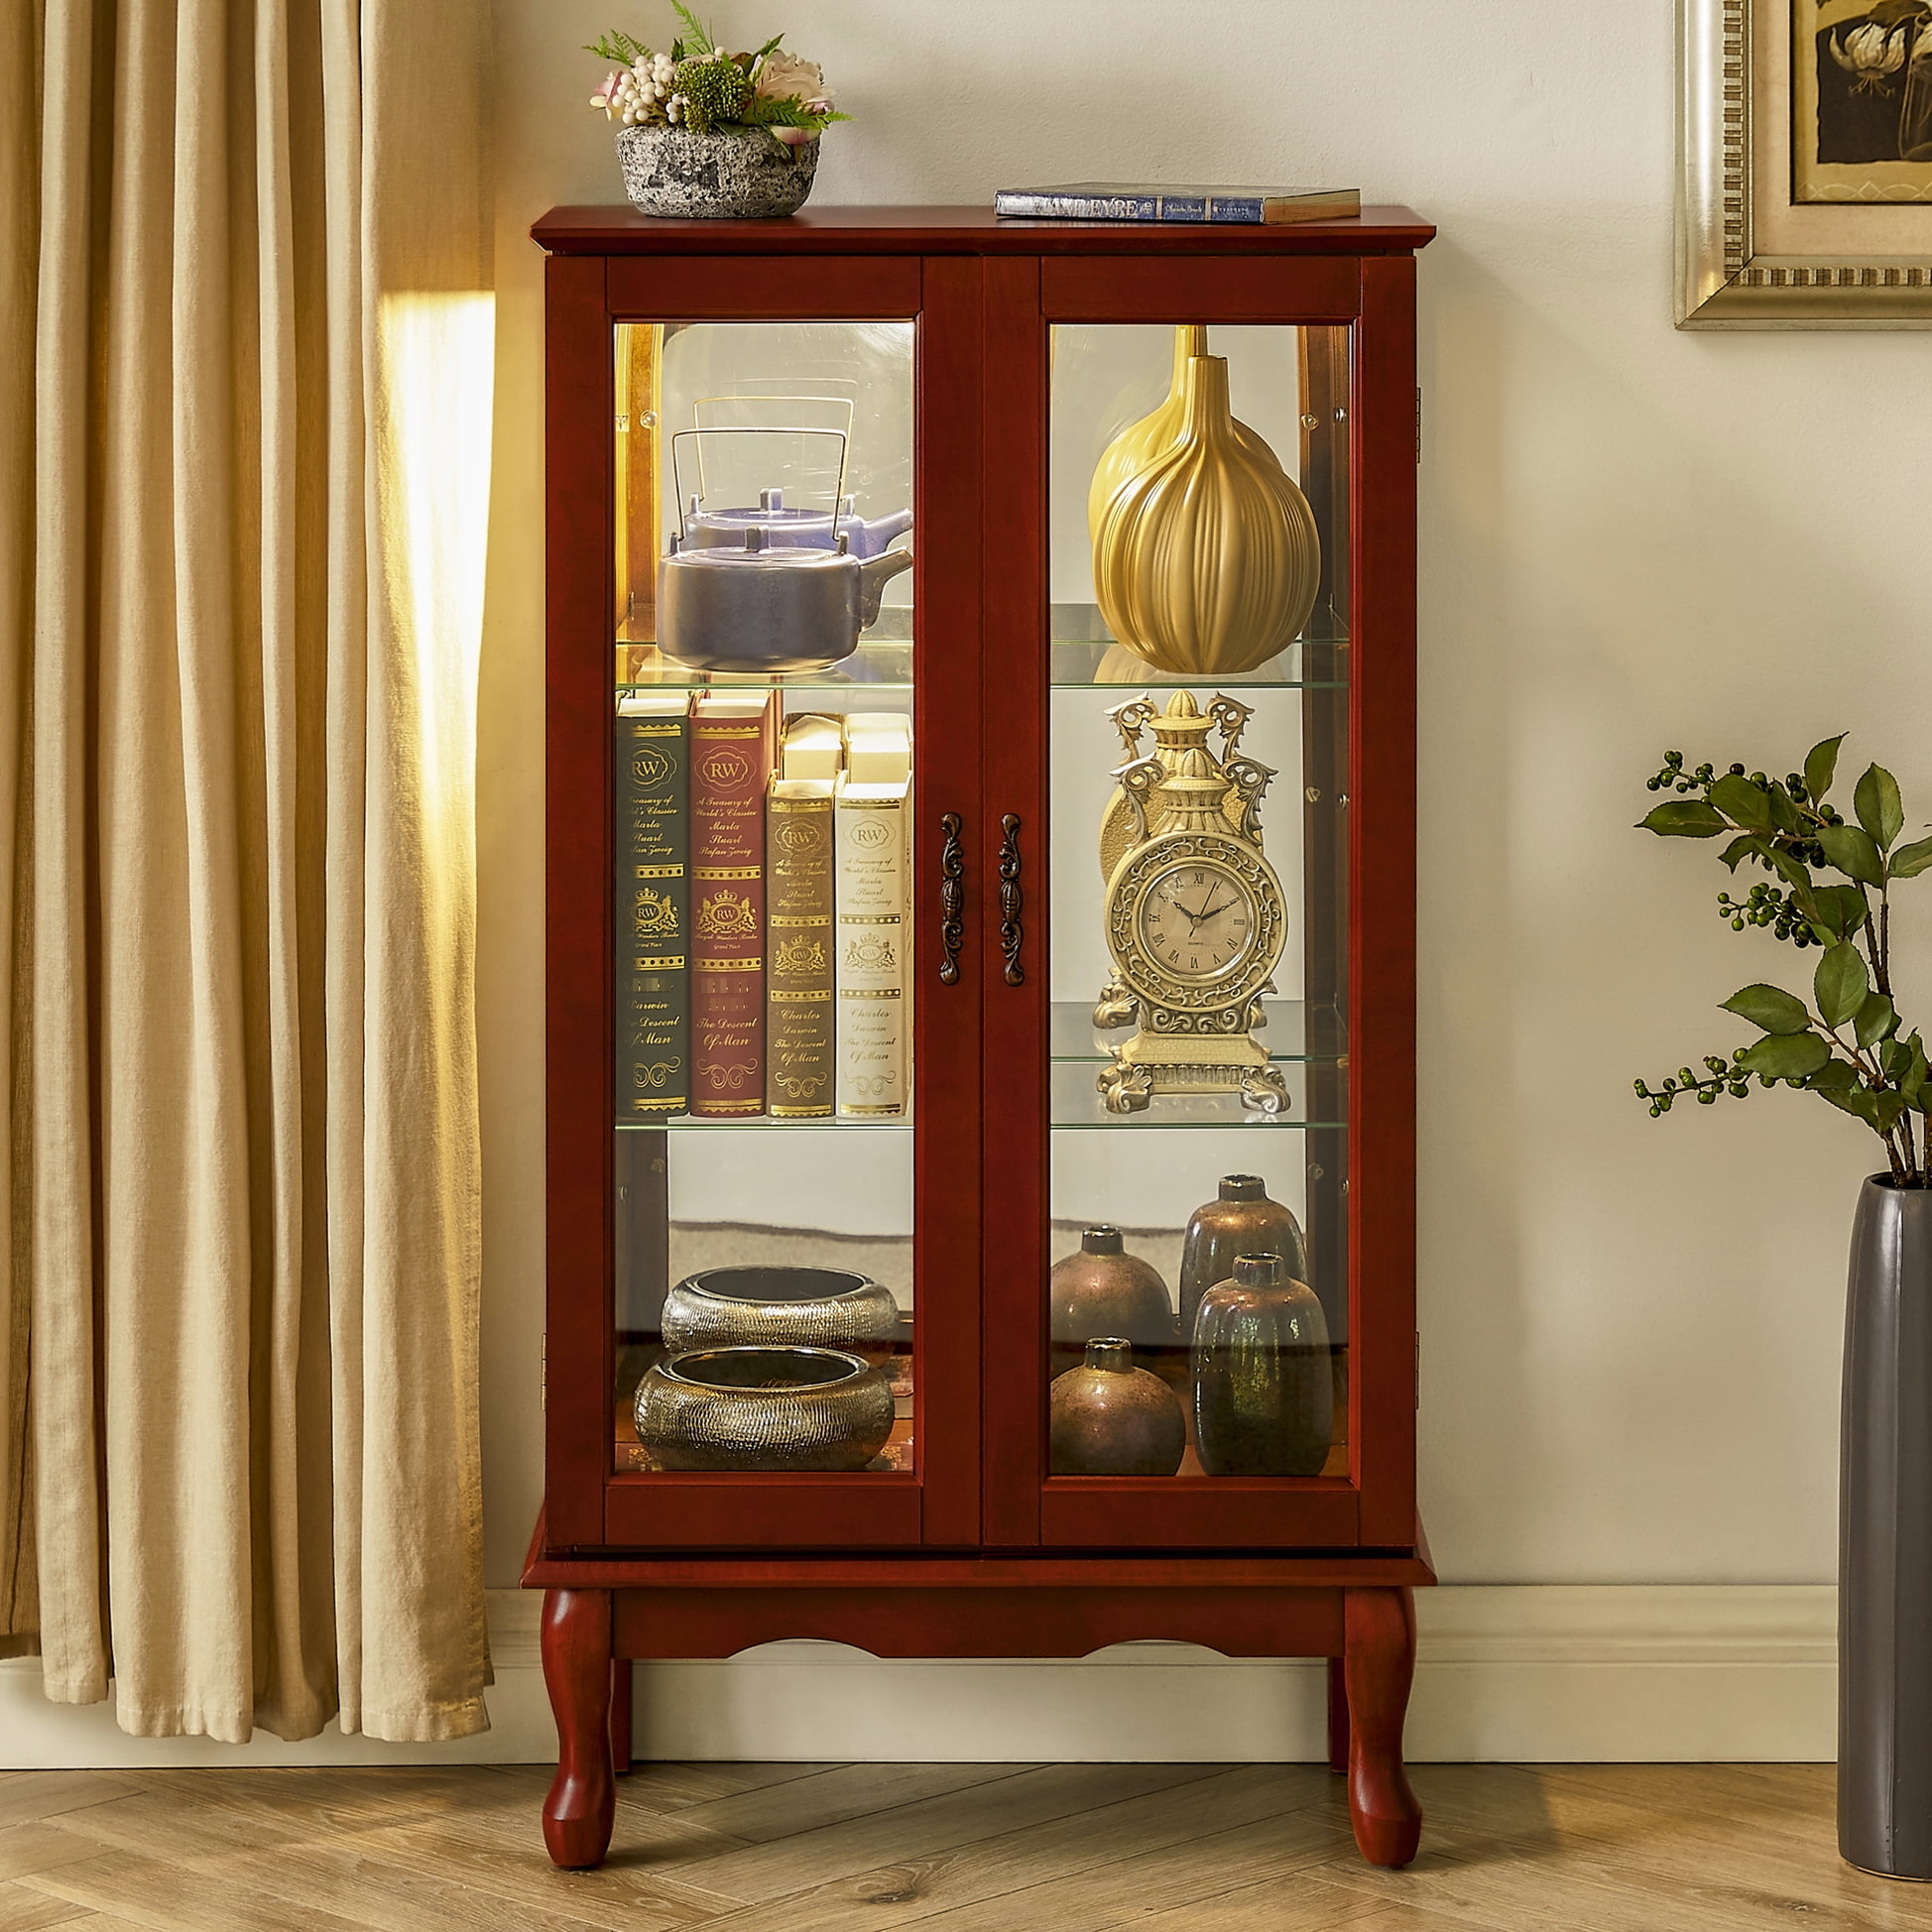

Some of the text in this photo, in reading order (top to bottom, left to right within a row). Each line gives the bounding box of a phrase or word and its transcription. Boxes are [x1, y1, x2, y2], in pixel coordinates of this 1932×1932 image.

[1090, 198, 1139, 217] EYRE
[631, 760, 661, 777] RW
[710, 762, 741, 779] RW
[706, 796, 742, 808] Treasury
[787, 831, 813, 844] RW
[857, 829, 883, 842] RW
[1193, 872, 1205, 884] XII
[637, 907, 658, 918] RW
[716, 909, 736, 920] RW
[781, 1008, 822, 1021] Charles
[849, 1008, 890, 1019] Charles
[639, 1015, 681, 1028] Descent
[695, 1018, 759, 1029] The Descent
[783, 1026, 818, 1034] Darwin
[640, 1031, 673, 1045] Man
[703, 1032, 752, 1051] Of Man
[775, 1038, 827, 1048] The Descent
[781, 1052, 820, 1066] Of Man
[863, 1050, 890, 1060] Man
